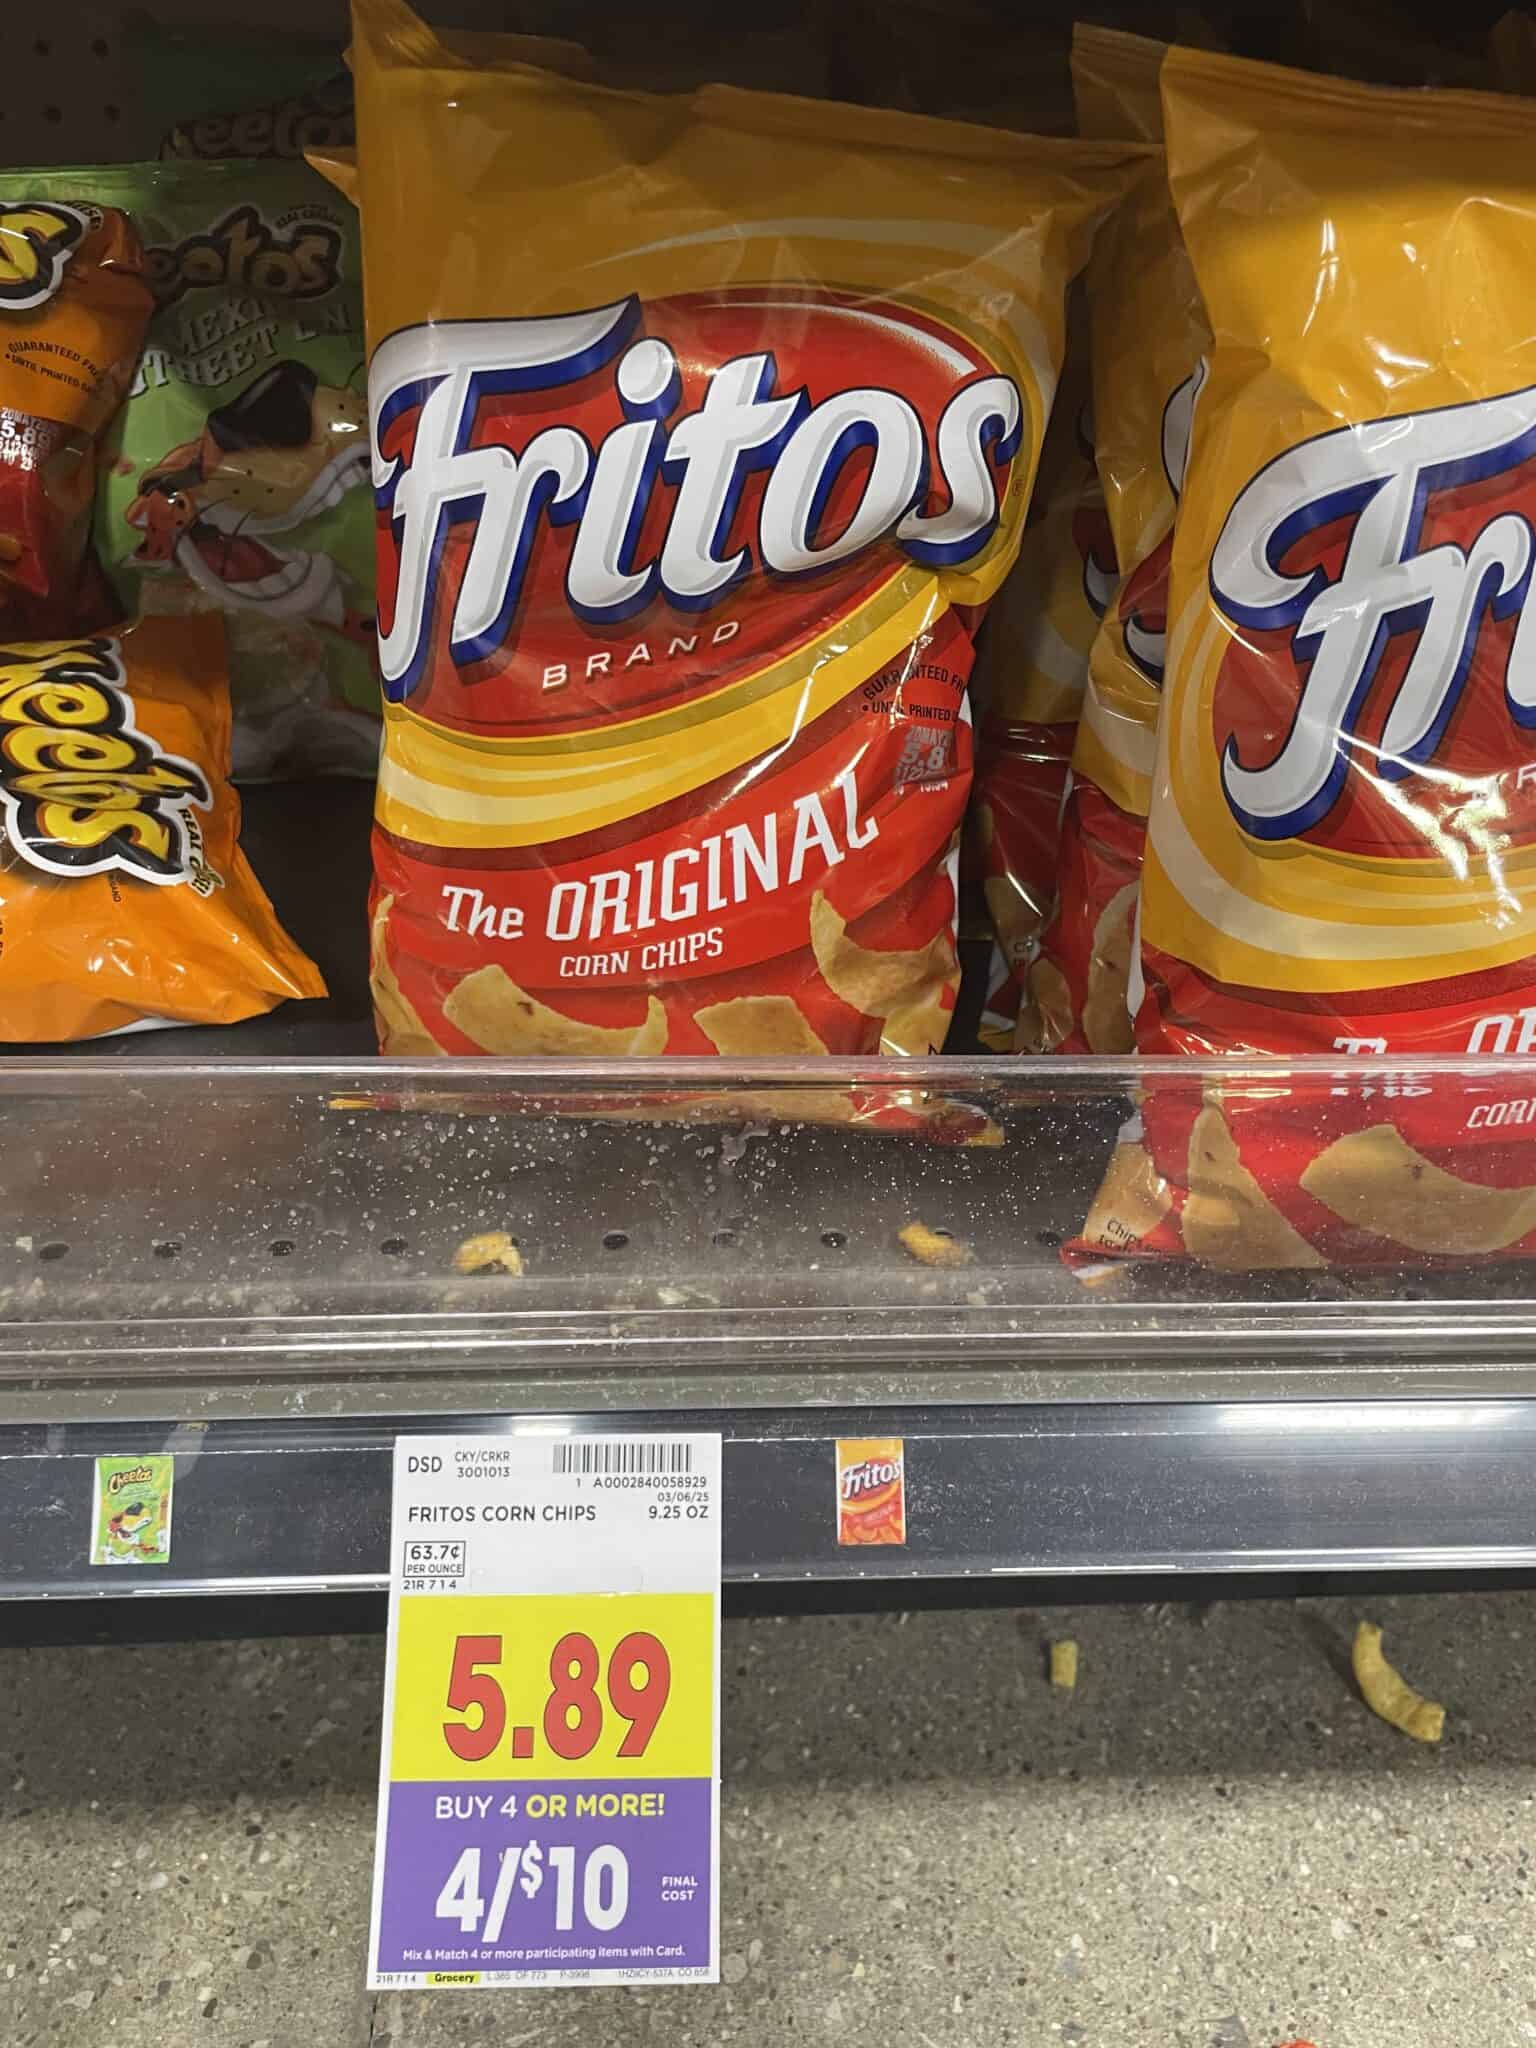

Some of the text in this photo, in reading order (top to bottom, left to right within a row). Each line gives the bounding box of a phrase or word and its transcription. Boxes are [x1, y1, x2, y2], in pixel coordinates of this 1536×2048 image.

[8, 341, 80, 361] GUARANTEED
[40, 366, 80, 387] PRINTED
[365, 293, 1023, 703] Fritos
[543, 621, 740, 690] BRAND
[863, 665, 949, 700] GUARNTEED
[909, 704, 951, 721] PRINTED
[177, 808, 202, 851] REAL
[442, 772, 880, 943] The ORIGINAL
[559, 927, 725, 979] CORN CHIPS
[408, 1450, 510, 1473] DSD CKY/CRKR
[457, 1466, 510, 1478] 3001013
[840, 1461, 901, 1500] Fritos
[593, 1476, 707, 1489] A0002840058929
[657, 1491, 709, 1503] 03/06/25
[408, 1505, 709, 1522] FRITOS CORN CHIPS 9.25 OZ
[410, 1545, 461, 1560] 63.7¢
[407, 1563, 462, 1574] PER OUNCE
[443, 1631, 671, 1762] 5.89
[435, 1793, 665, 1819] BUY 4 OR MORE!
[662, 1876, 698, 1887] FINAL
[662, 1890, 694, 1901] COST
[403, 1944, 685, 1961] Mix & Match 4 or more participating items with Card.
[434, 1973, 475, 1984] Grocery
